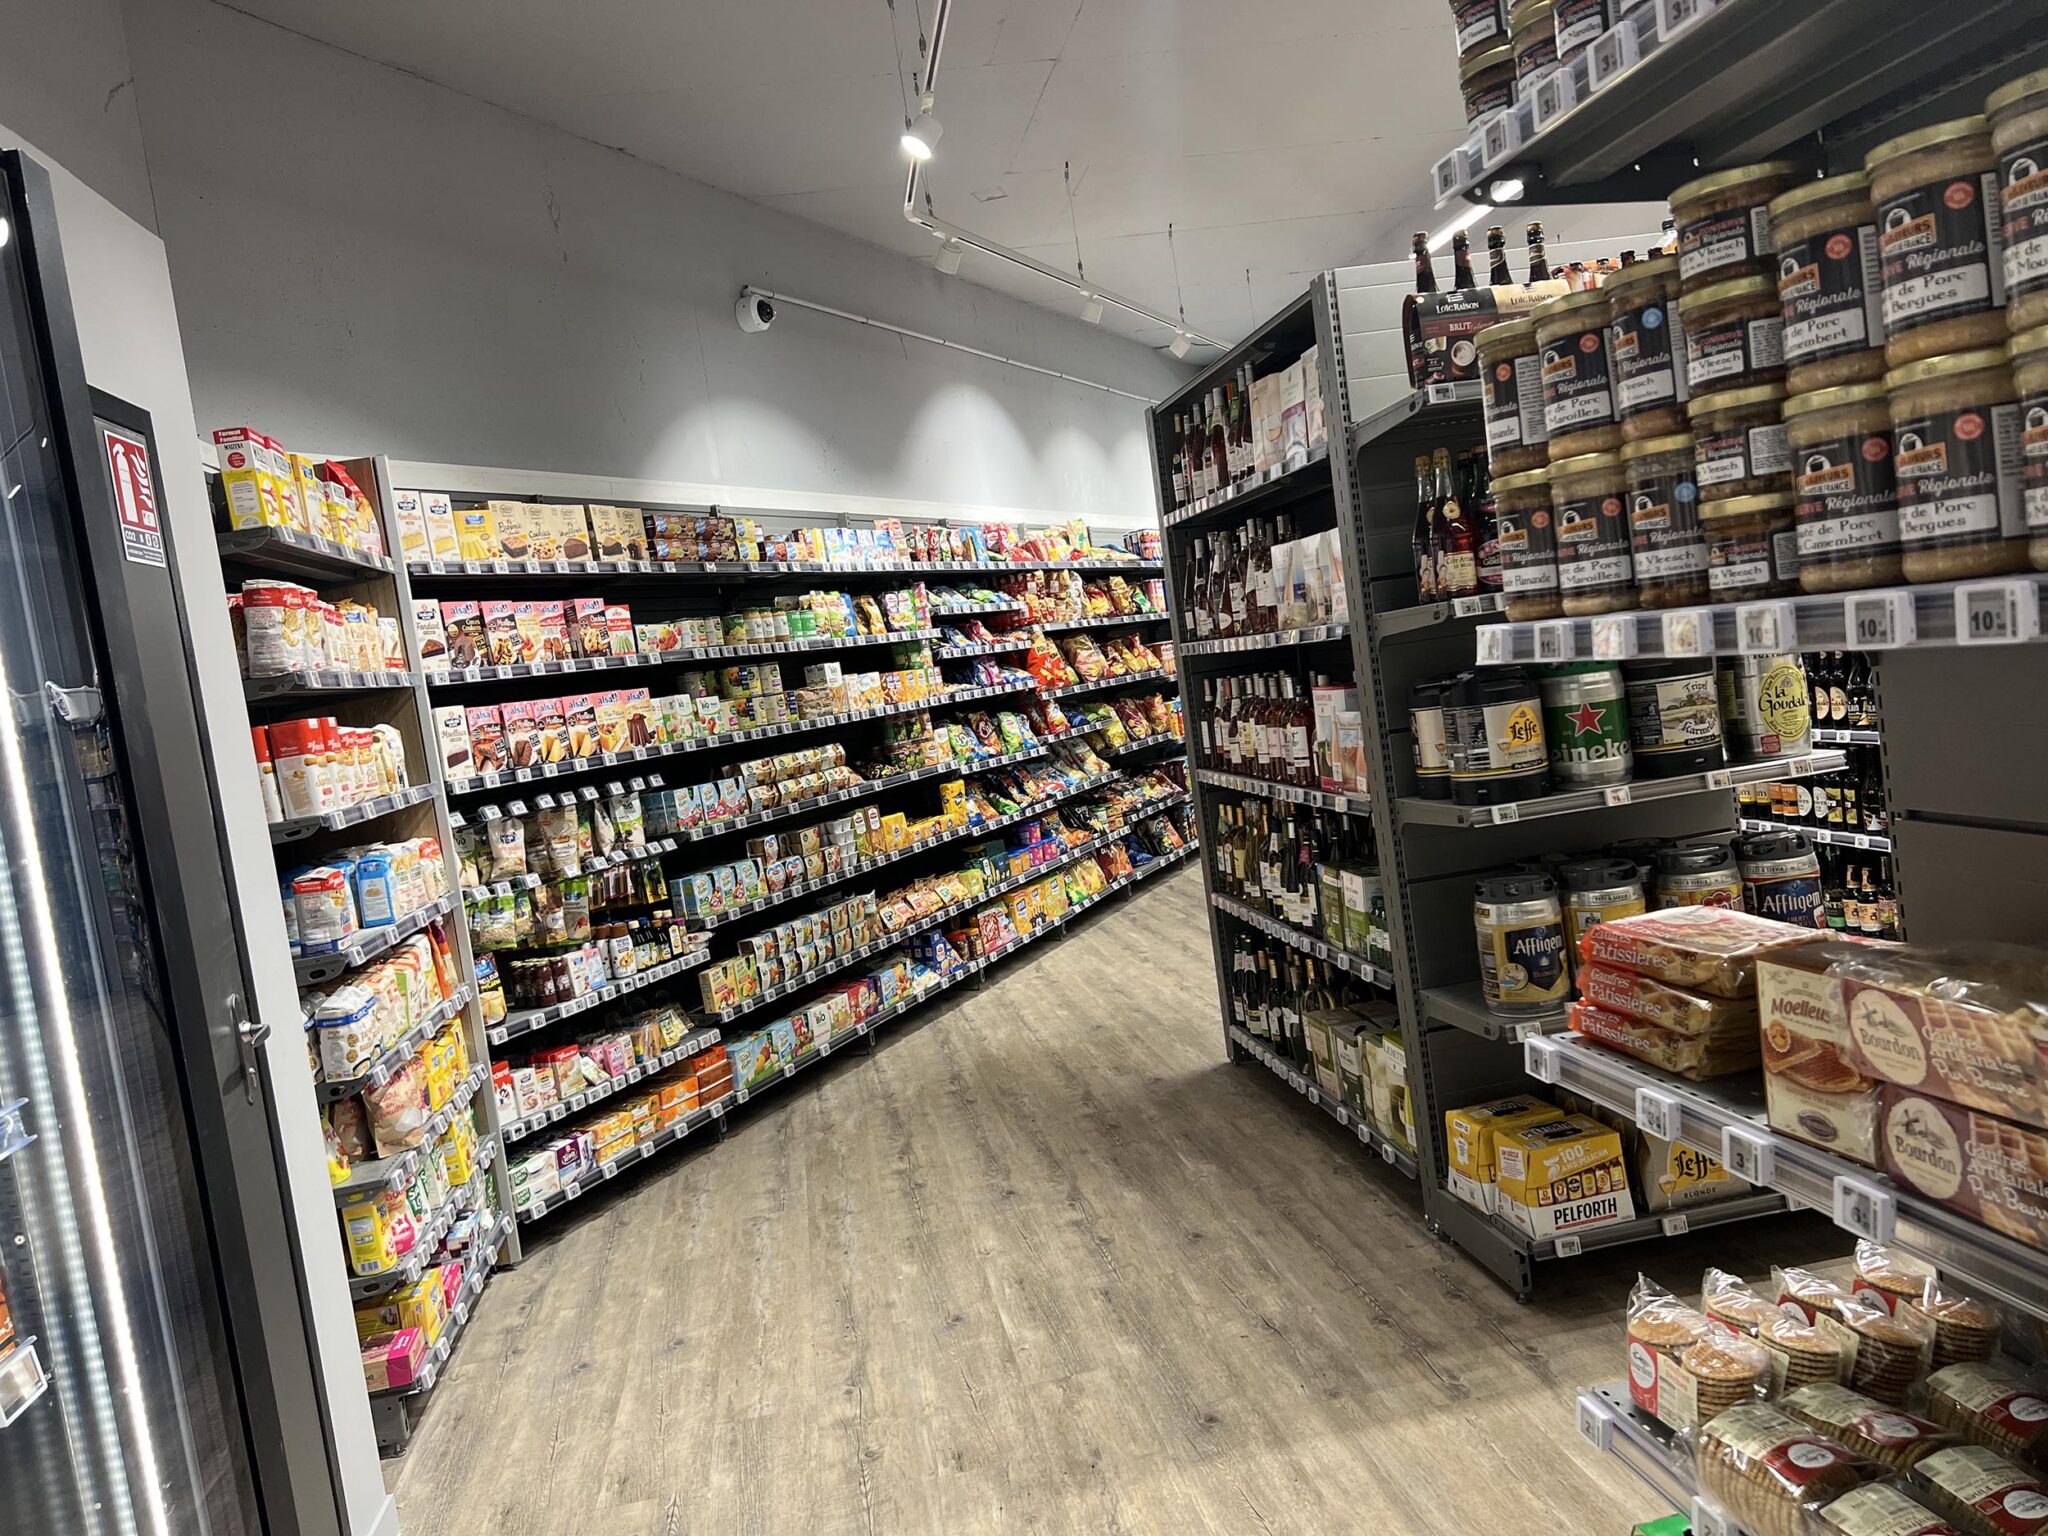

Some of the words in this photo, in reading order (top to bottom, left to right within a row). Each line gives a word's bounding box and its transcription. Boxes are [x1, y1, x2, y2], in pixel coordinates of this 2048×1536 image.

[1905, 239, 1986, 270] Régionale
[1897, 283, 1916, 297] de
[1922, 271, 1967, 289] Porc
[1795, 286, 1863, 315] Régionale
[1891, 287, 1959, 313] Bergues
[1807, 316, 1840, 333] Porc
[1556, 375, 1609, 396] Régionale
[1570, 395, 1601, 411] Porc
[1917, 472, 1994, 498] Régionale
[1825, 488, 1897, 513] Régionale
[1910, 505, 1927, 520] de
[1933, 499, 1977, 515] Porc
[1817, 523, 1834, 536] de
[1839, 518, 1875, 533] Porc
[1904, 515, 1967, 534] Bergues
[1802, 531, 1885, 551] Camembert
[1591, 559, 1623, 572] Porc
[1858, 618, 1877, 639] 10
[1970, 611, 1994, 632] 10
[1774, 685, 1788, 699] la
[1508, 717, 1538, 744] Leffe
[1550, 738, 1630, 763] eineke
[1761, 891, 1821, 916] Affligem
[1513, 934, 1564, 958] Affligem
[1591, 940, 1670, 970] Pâtissières
[1590, 968, 1631, 989] Gaufres
[1588, 982, 1663, 1019] Pâtissières
[1580, 1015, 1652, 1052] Pâtissières
[1858, 1027, 1922, 1061] Bourdon
[1931, 1057, 1968, 1083] Pur
[1559, 1144, 1584, 1164] 100
[1895, 1135, 1958, 1176] Bourdon
[1964, 1139, 2028, 1174] Gaufres
[1966, 1159, 2048, 1198] Artisanale
[1683, 1186, 1718, 1199] BLONDE
[1966, 1174, 2001, 1204] Pur
[2002, 1185, 2048, 1221] Beurr
[1553, 1196, 1618, 1226] PELFORTH
